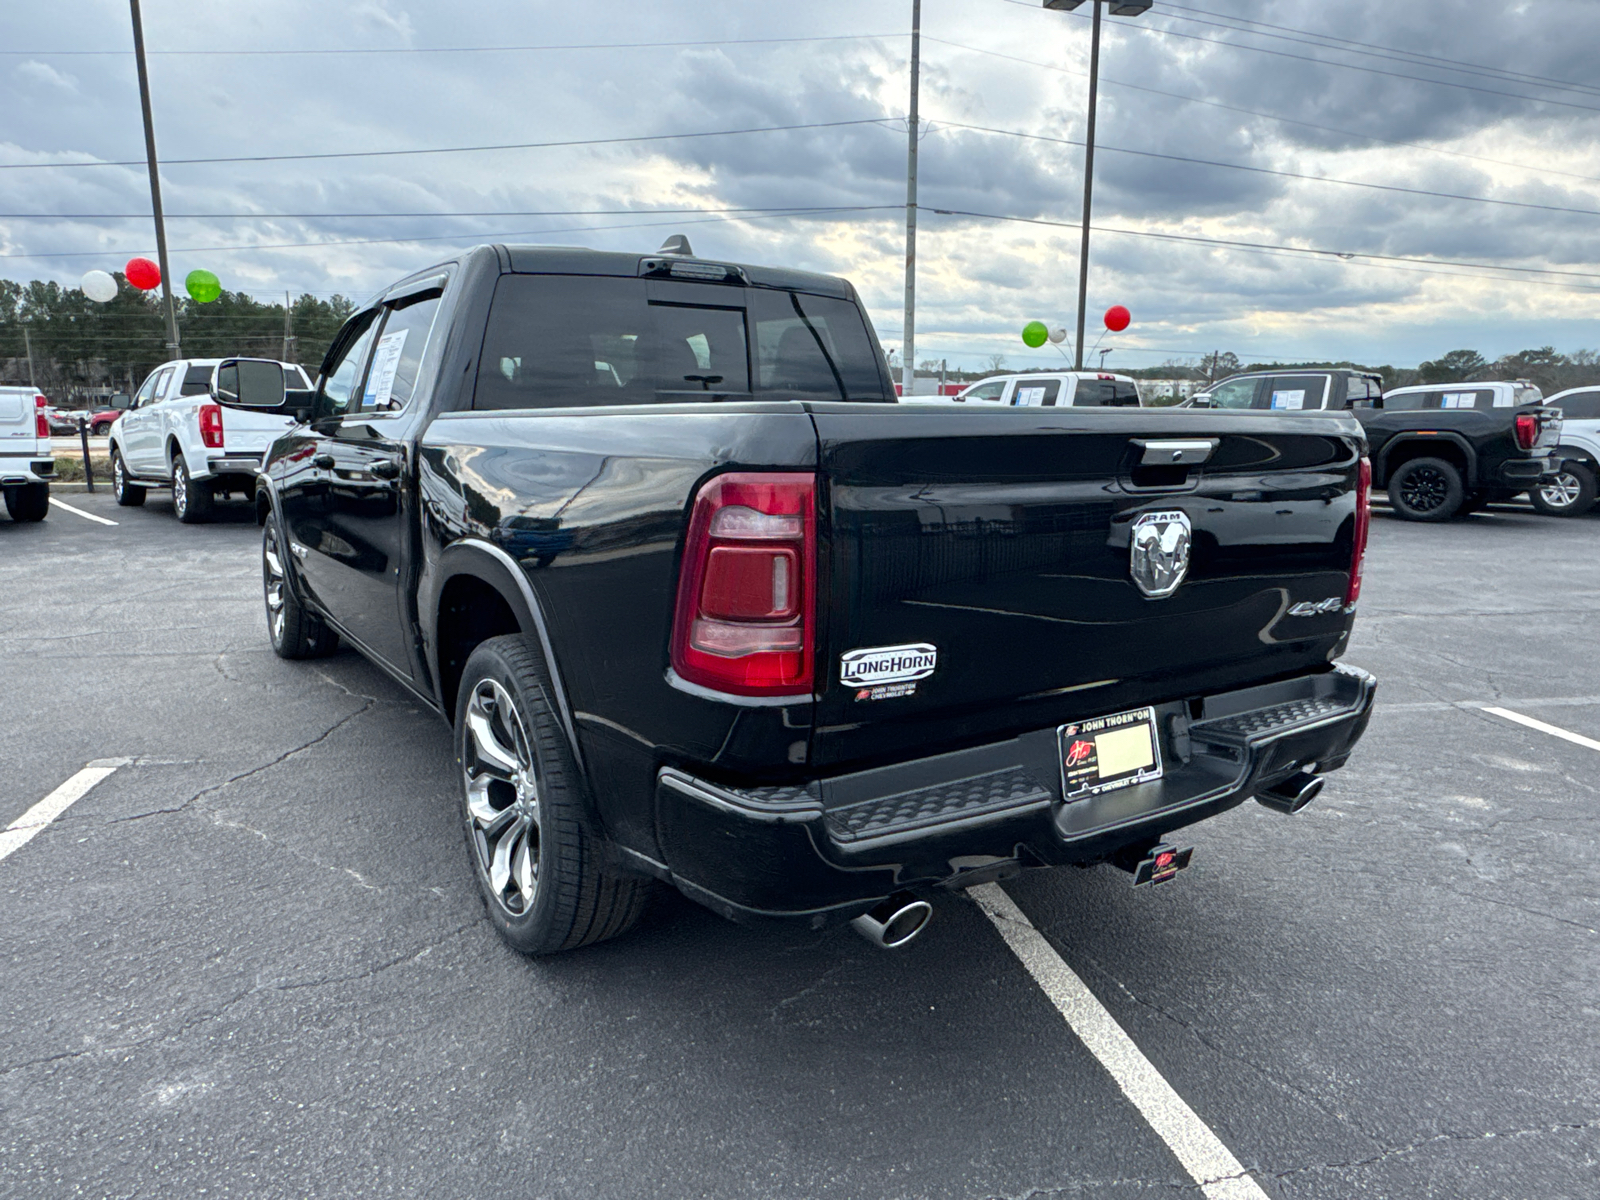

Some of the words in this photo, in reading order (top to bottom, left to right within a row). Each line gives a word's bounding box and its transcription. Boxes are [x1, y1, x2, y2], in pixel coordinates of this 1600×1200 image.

[1147, 513, 1181, 522] RAM
[843, 654, 935, 678] LONGHORN
[1082, 719, 1105, 733] JOHN
